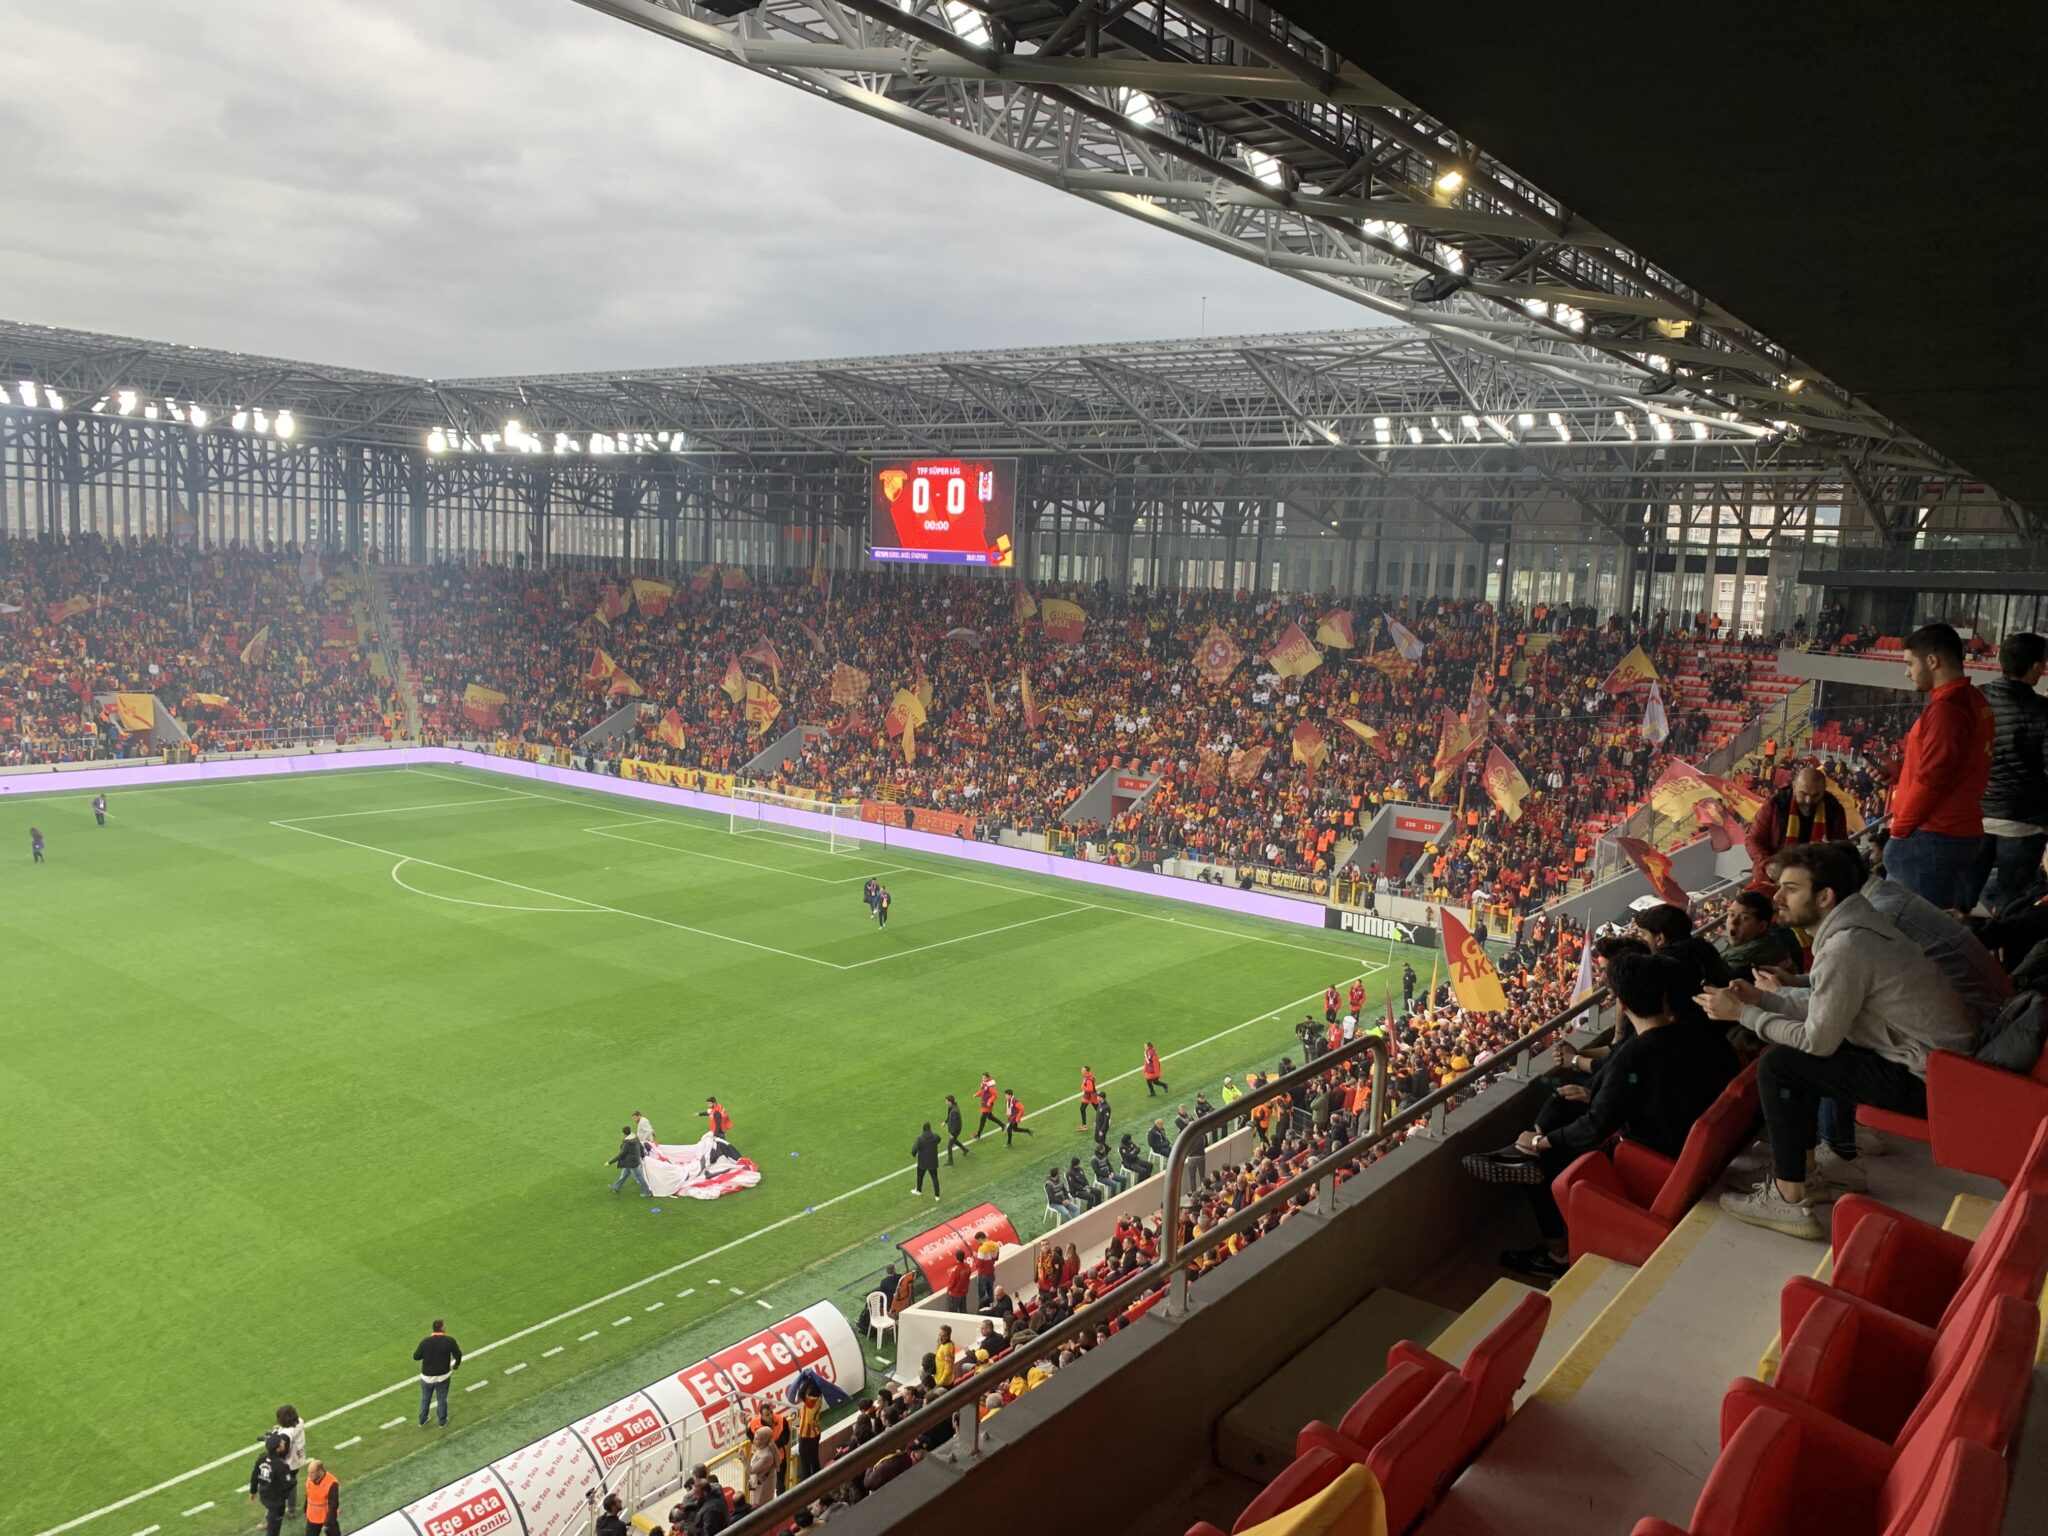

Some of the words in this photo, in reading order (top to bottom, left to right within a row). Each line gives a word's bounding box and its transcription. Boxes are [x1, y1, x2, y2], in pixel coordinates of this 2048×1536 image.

[917, 467, 928, 475] TFF
[929, 466, 949, 475] SÜPER
[950, 466, 960, 475] LİG
[912, 478, 929, 514] 0
[947, 478, 965, 515] 0
[924, 520, 949, 531] 00:00
[878, 808, 904, 822] FORZ
[1340, 911, 1396, 940] PUMA
[688, 1361, 753, 1408] Ege
[747, 1329, 818, 1373] Teta
[595, 1431, 625, 1452] Ege
[623, 1415, 656, 1438] Teta
[545, 1467, 556, 1478] Ege
[553, 1454, 564, 1466] Teta
[521, 1480, 532, 1490] Ege
[529, 1467, 540, 1478] Teta
[556, 1489, 566, 1500] Ege
[564, 1474, 575, 1488] Teta
[580, 1475, 590, 1486] Ege
[531, 1502, 542, 1512] Ege
[540, 1488, 550, 1500] Teta
[429, 1515, 463, 1536] Ege
[462, 1495, 500, 1520] Teta
[548, 1512, 560, 1526] Teta
